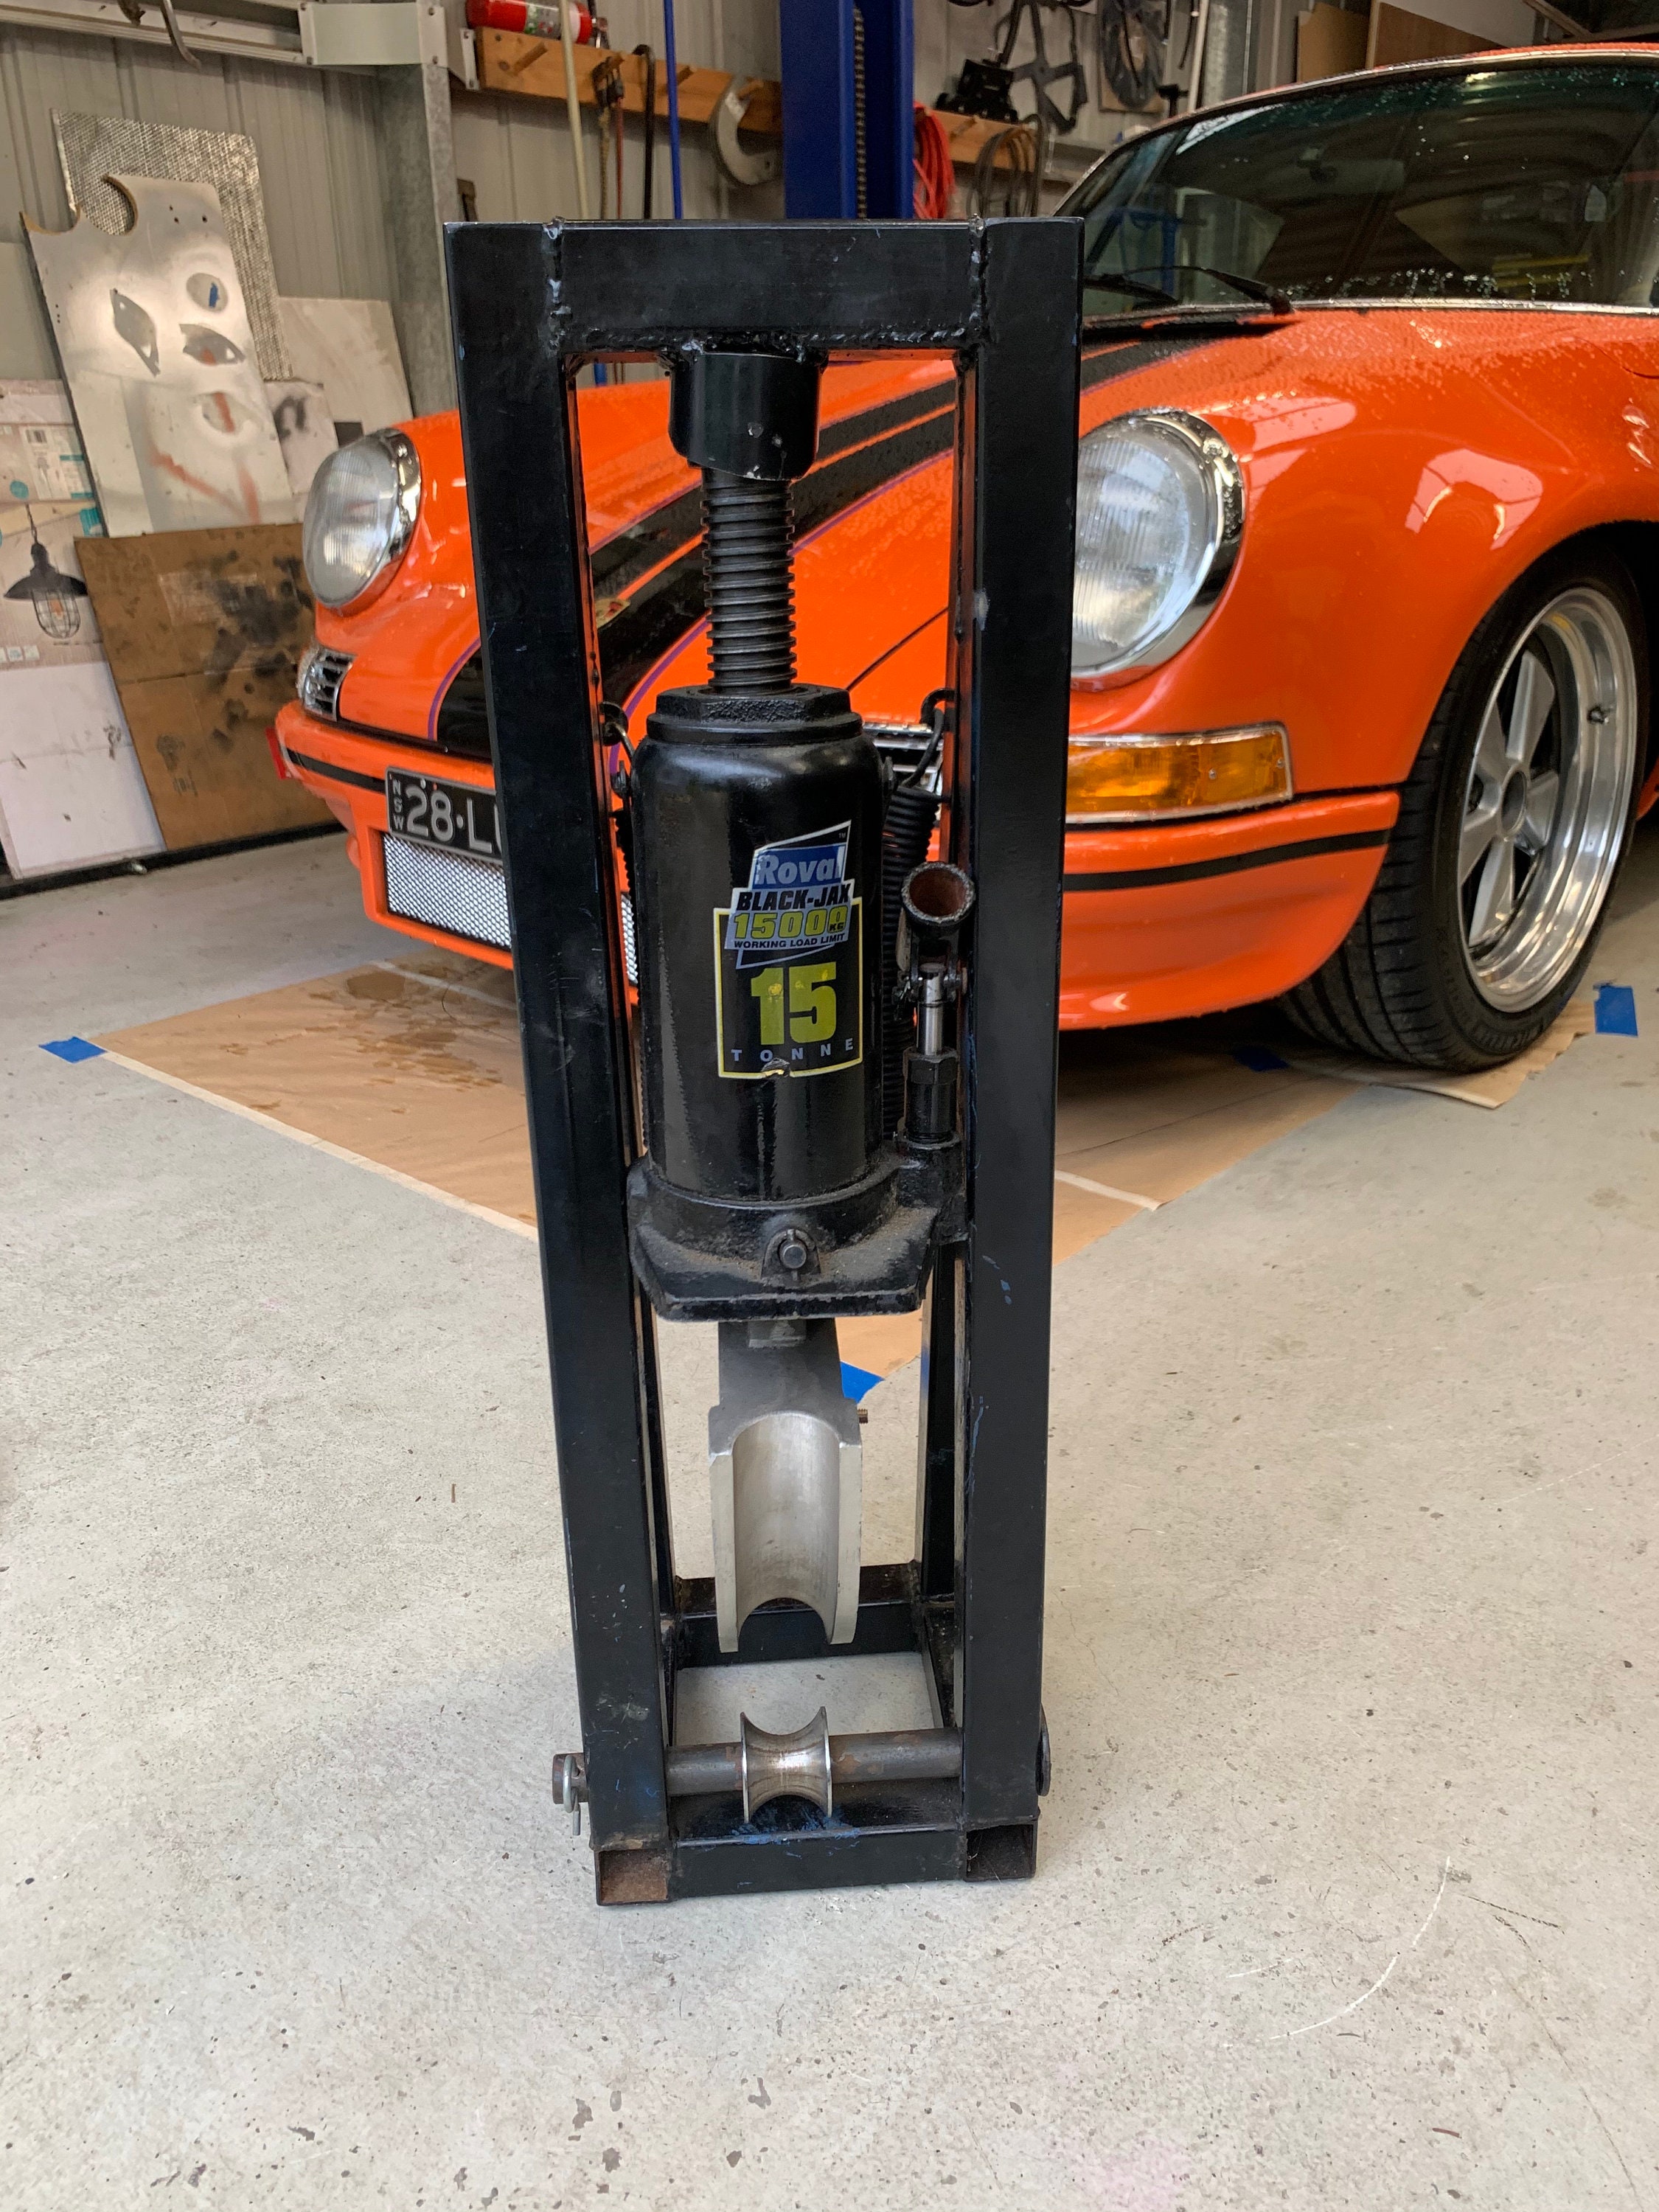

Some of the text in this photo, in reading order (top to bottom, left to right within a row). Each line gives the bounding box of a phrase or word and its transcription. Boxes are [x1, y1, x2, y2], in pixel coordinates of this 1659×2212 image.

[734, 933, 845, 948] WORKING LOAD LIMIT
[751, 962, 836, 1045] 15
[732, 1038, 853, 1062] TONNE
